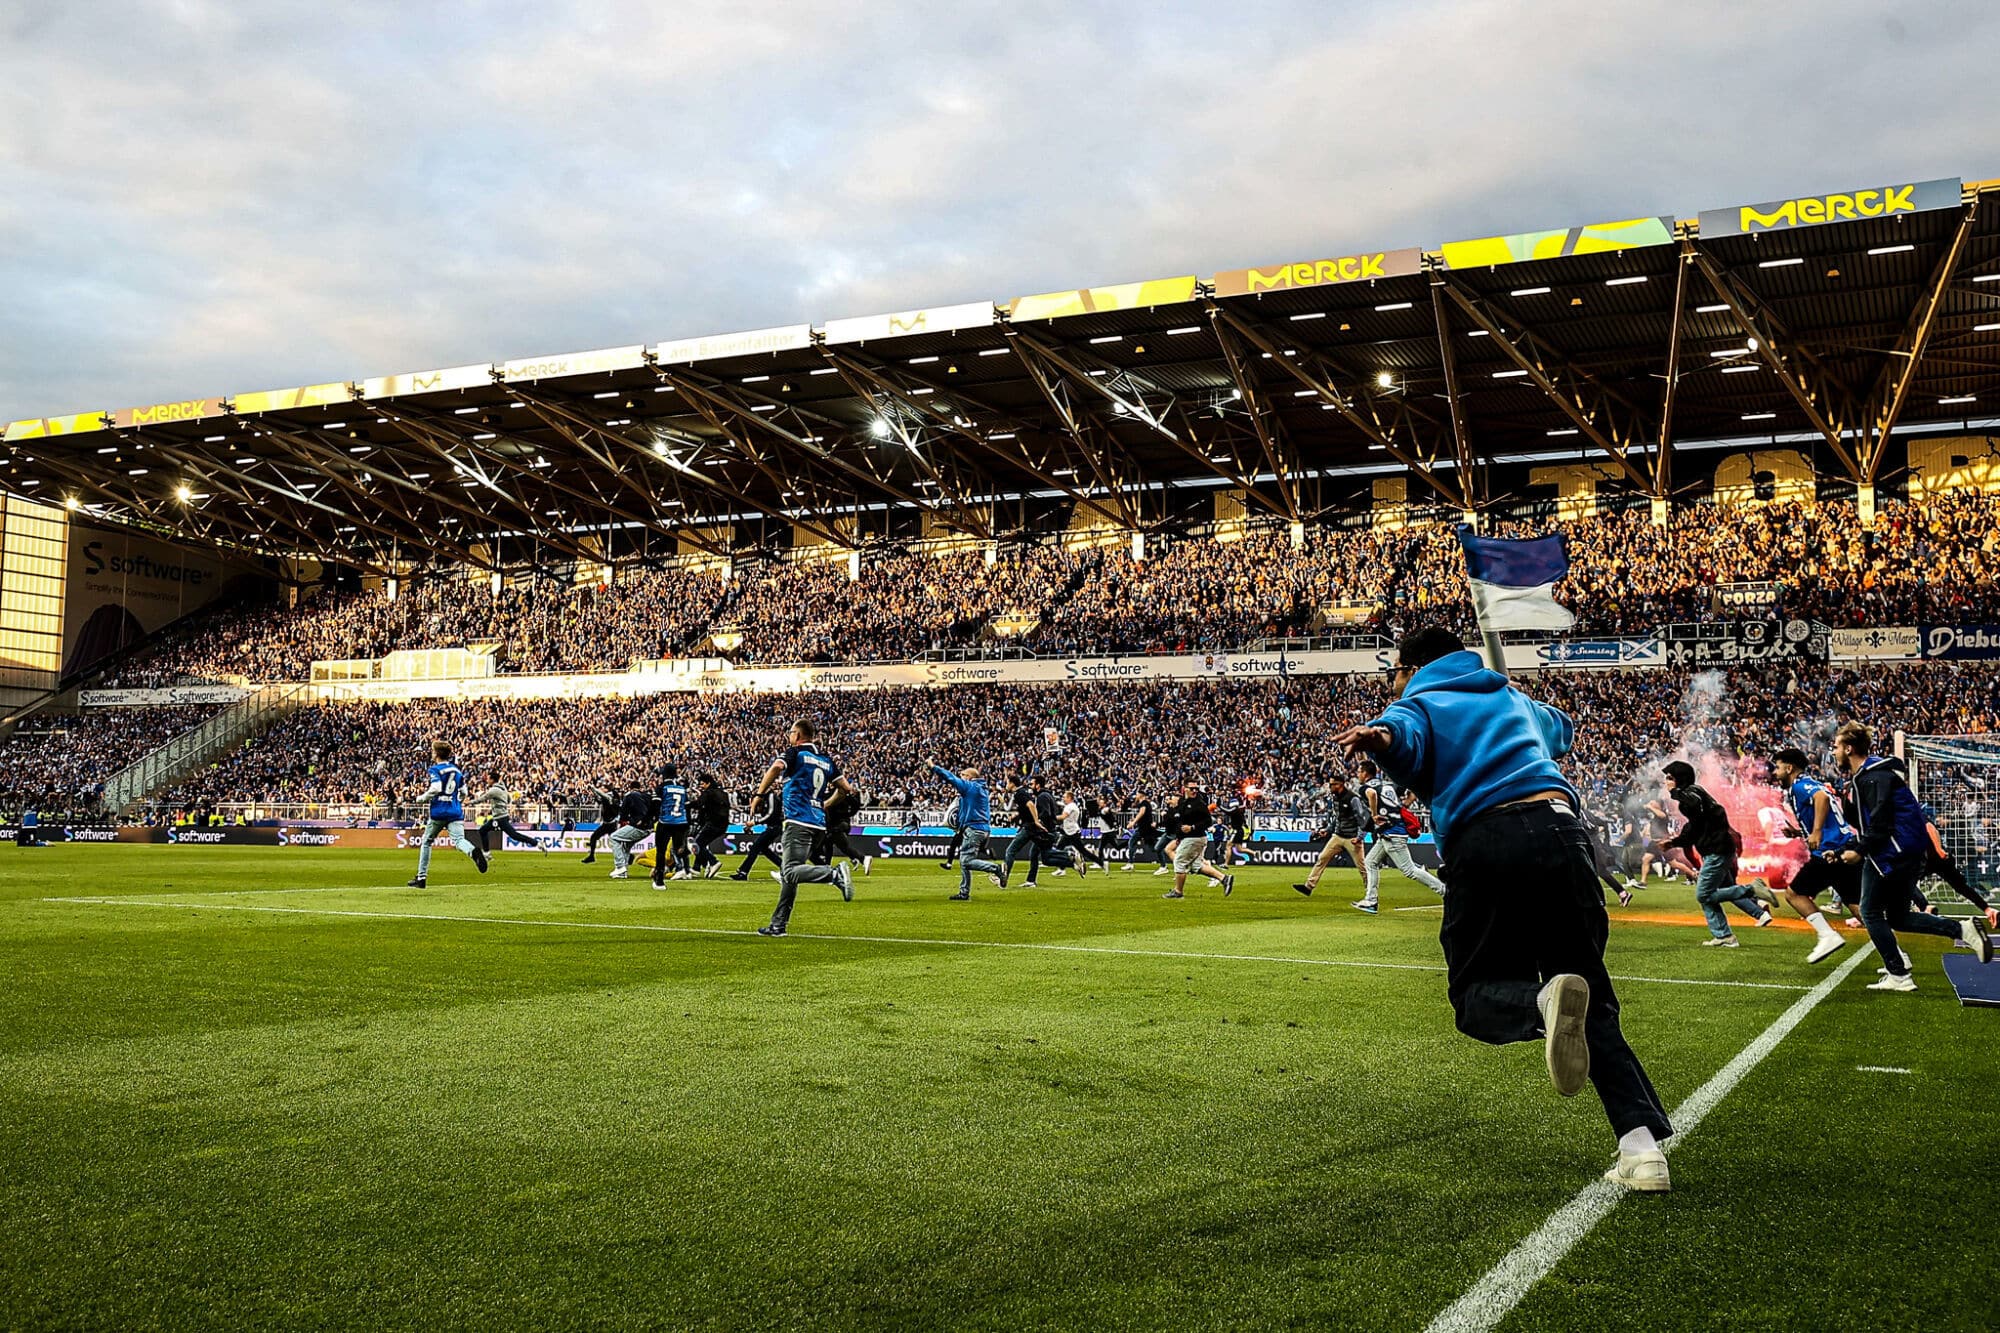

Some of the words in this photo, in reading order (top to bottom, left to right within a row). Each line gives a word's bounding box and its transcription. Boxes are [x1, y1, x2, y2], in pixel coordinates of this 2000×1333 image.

[1740, 184, 1915, 233] MERCK
[1247, 253, 1385, 292] MERCK
[132, 400, 206, 426] MERCK
[110, 555, 201, 584] software
[1722, 590, 1776, 605] FORZA
[1833, 633, 1862, 651] Village
[940, 667, 996, 680] software
[1080, 661, 1142, 675] software
[810, 671, 862, 684] software
[368, 686, 407, 696] software
[467, 683, 511, 693] software
[90, 694, 123, 703] software
[180, 691, 216, 702] software
[812, 767, 824, 799] 9
[672, 793, 682, 812] 7
[75, 830, 113, 841] software
[179, 830, 220, 842] software
[290, 833, 334, 845] software
[409, 836, 457, 846] soware
